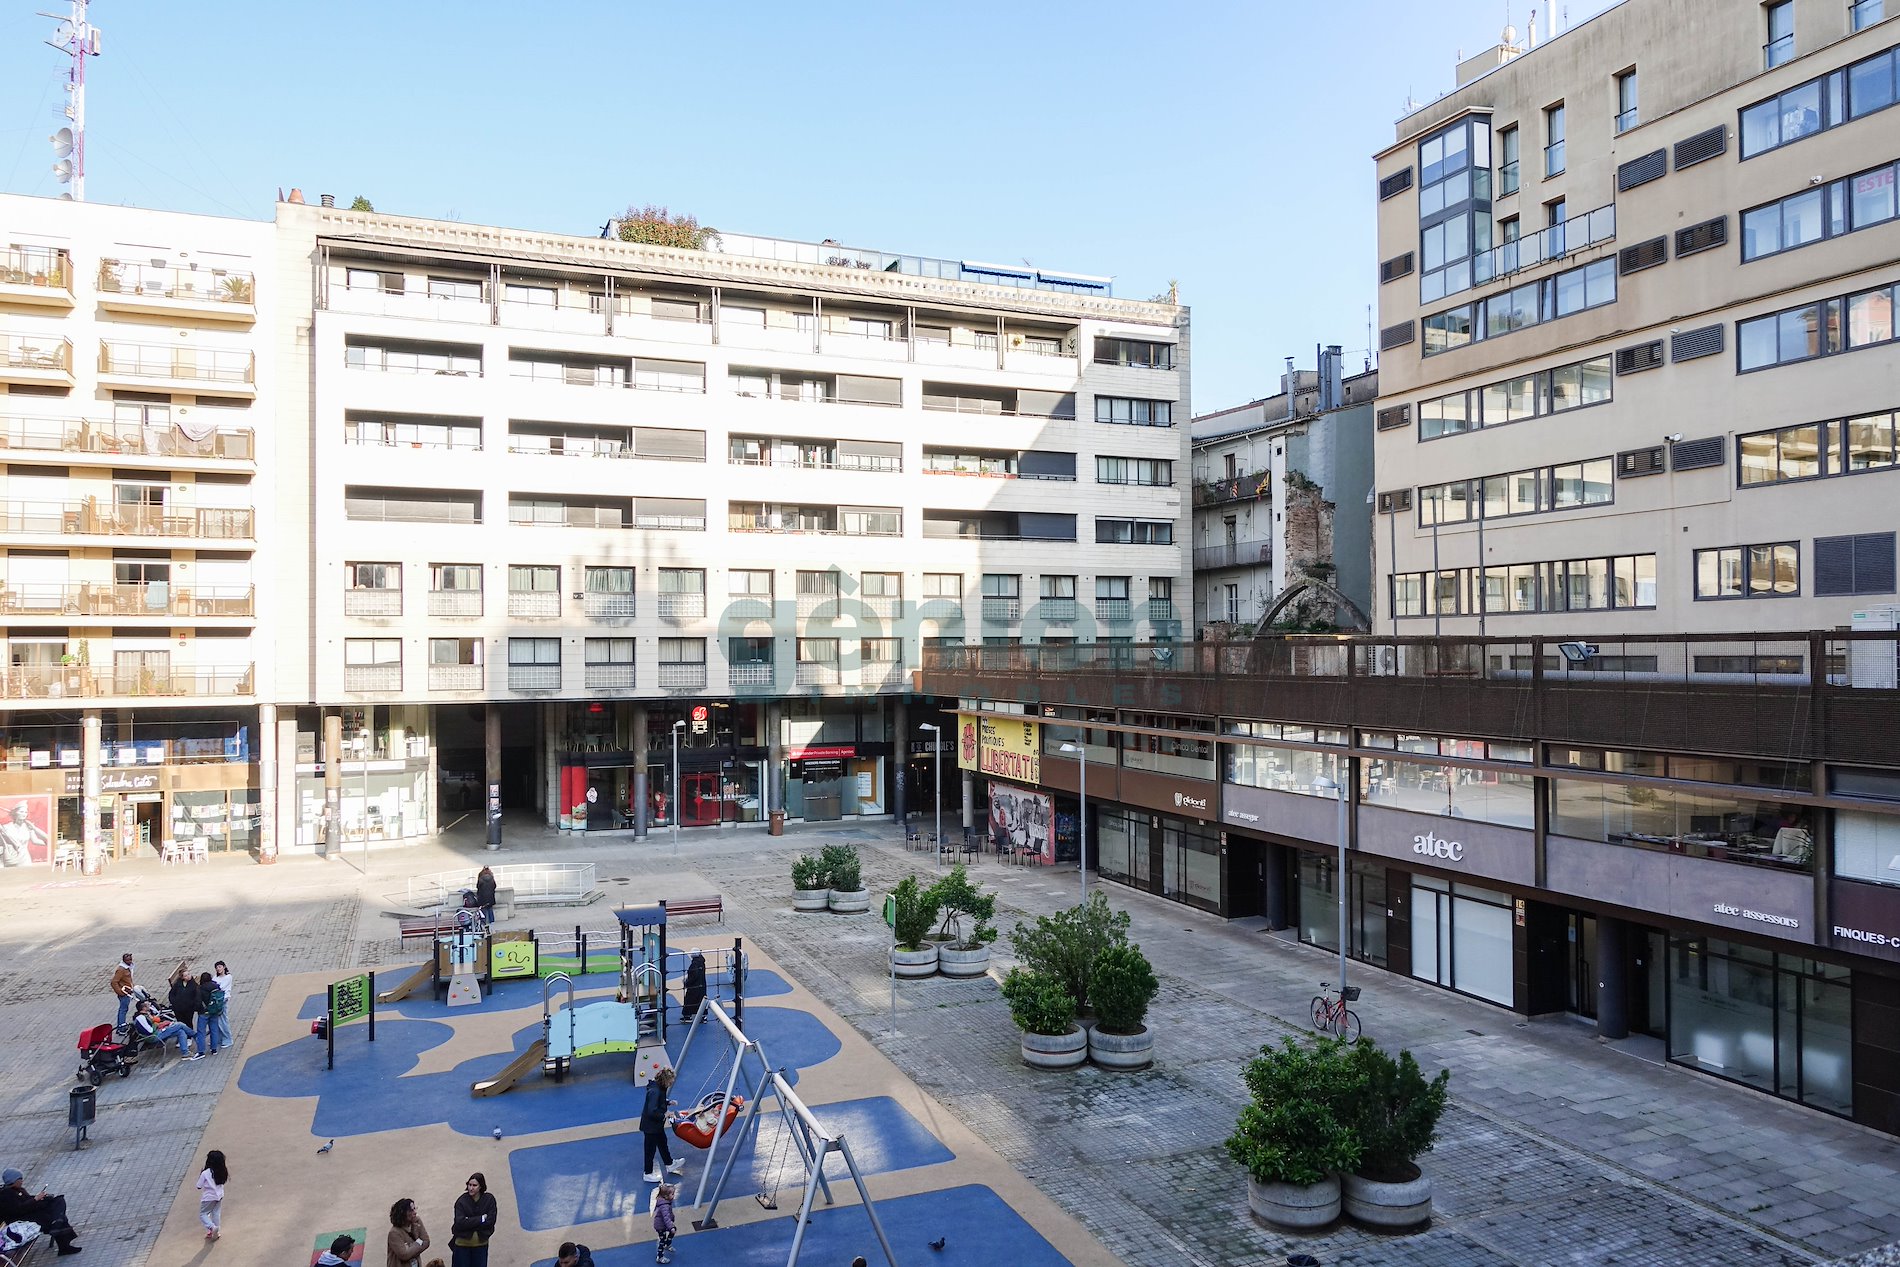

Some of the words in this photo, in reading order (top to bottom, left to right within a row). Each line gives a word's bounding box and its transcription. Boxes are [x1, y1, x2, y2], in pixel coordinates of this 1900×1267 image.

[1413, 831, 1463, 862] atec
[1713, 902, 1740, 917] atec
[1742, 909, 1799, 929] assessors
